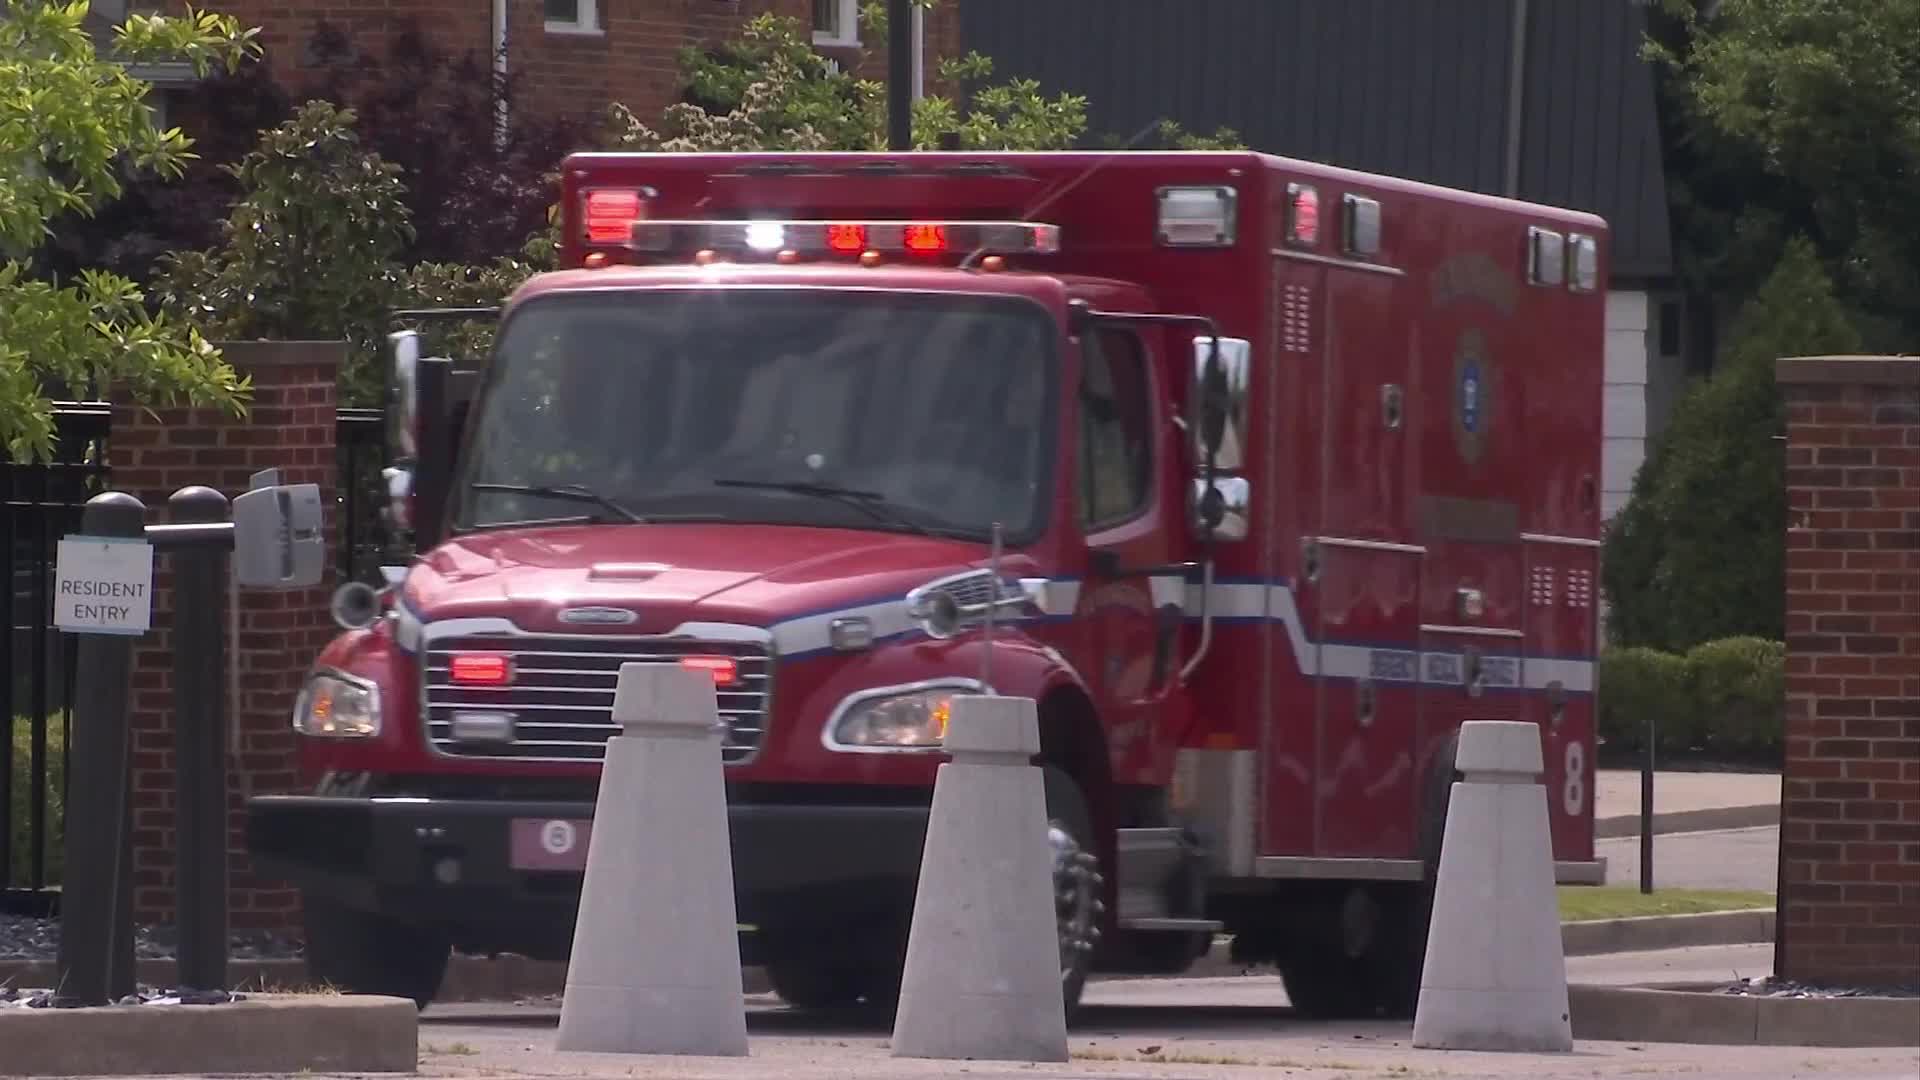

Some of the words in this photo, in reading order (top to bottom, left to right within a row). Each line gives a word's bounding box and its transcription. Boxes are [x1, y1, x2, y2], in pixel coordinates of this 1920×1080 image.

[61, 580, 145, 597] RESIDENT
[74, 604, 129, 620] ENTRY
[1564, 741, 1584, 816] 8
